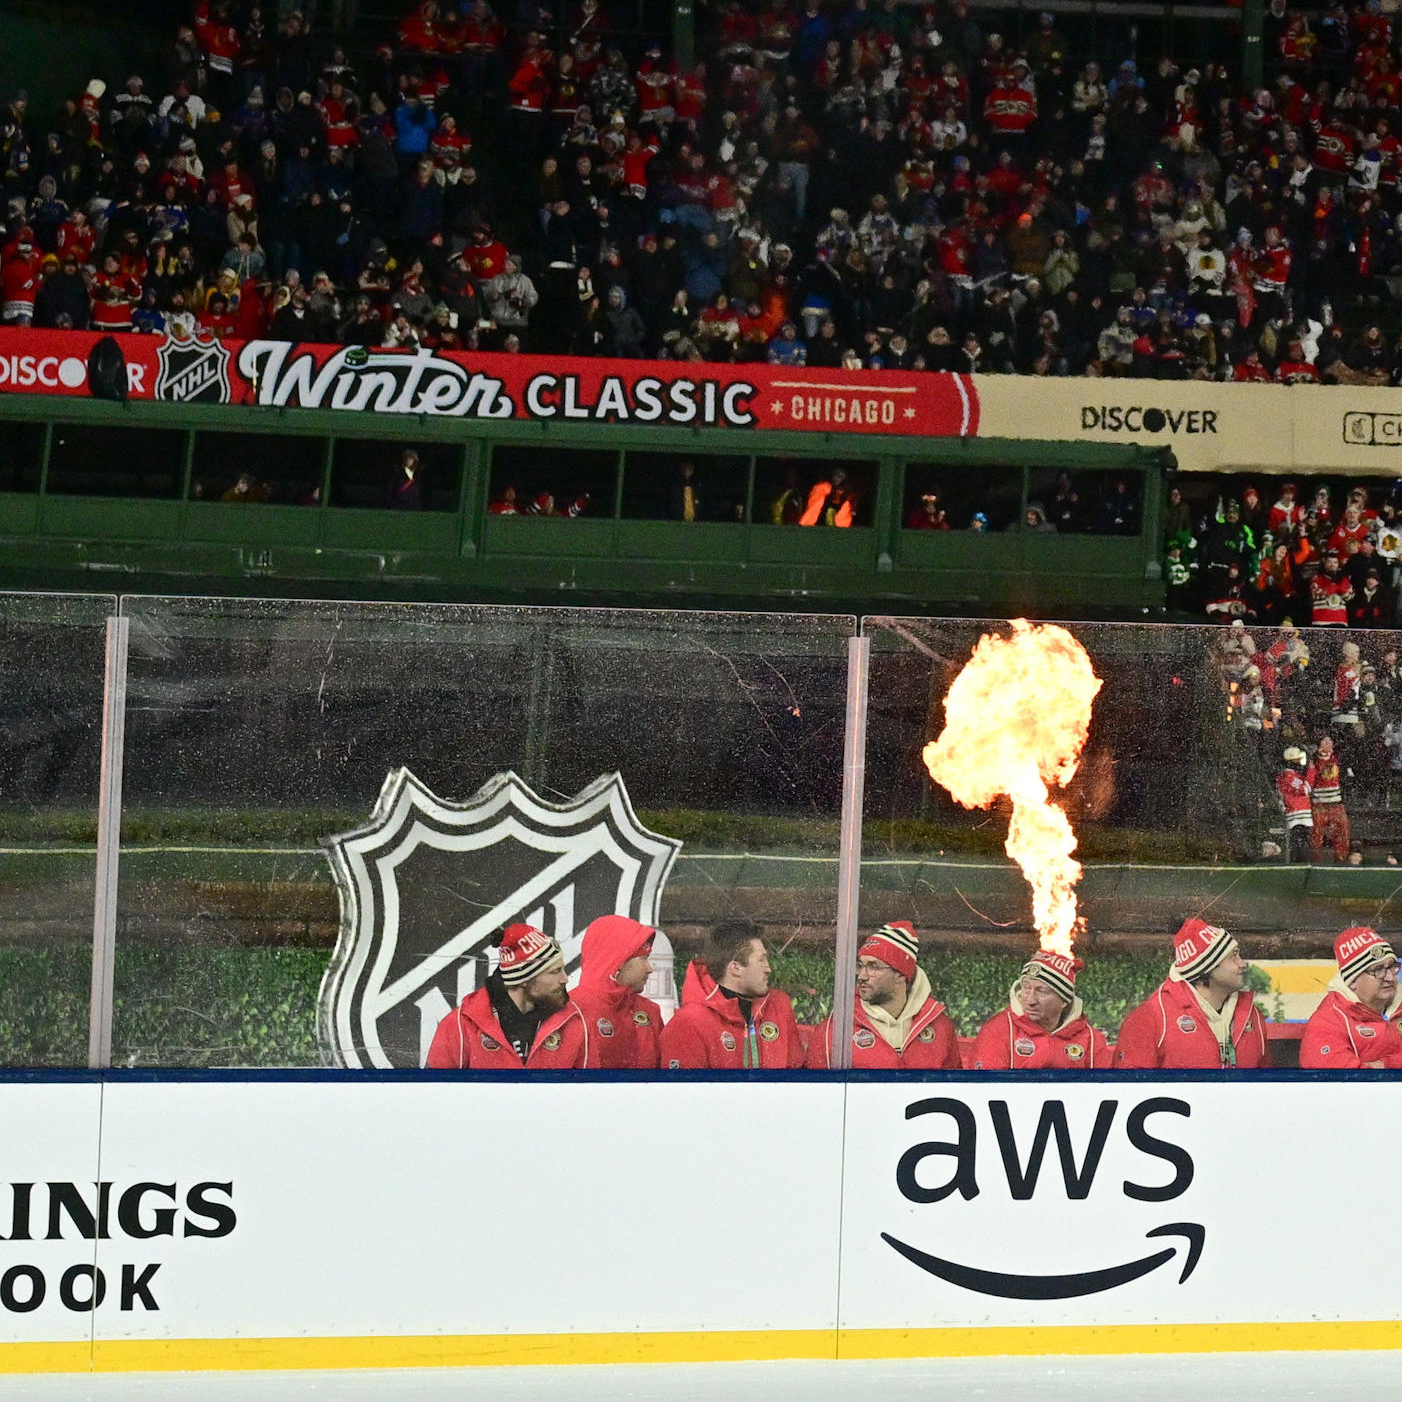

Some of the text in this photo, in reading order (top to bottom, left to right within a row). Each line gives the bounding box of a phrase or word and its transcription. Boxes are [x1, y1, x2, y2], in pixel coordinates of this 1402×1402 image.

[172, 361, 217, 402] NHL
[239, 339, 755, 426] Winter CLASSIC
[791, 395, 896, 425] CHICAGO
[1081, 406, 1218, 435] DISCOVER
[896, 1097, 1195, 1204] aws
[0, 1181, 237, 1241] INGS
